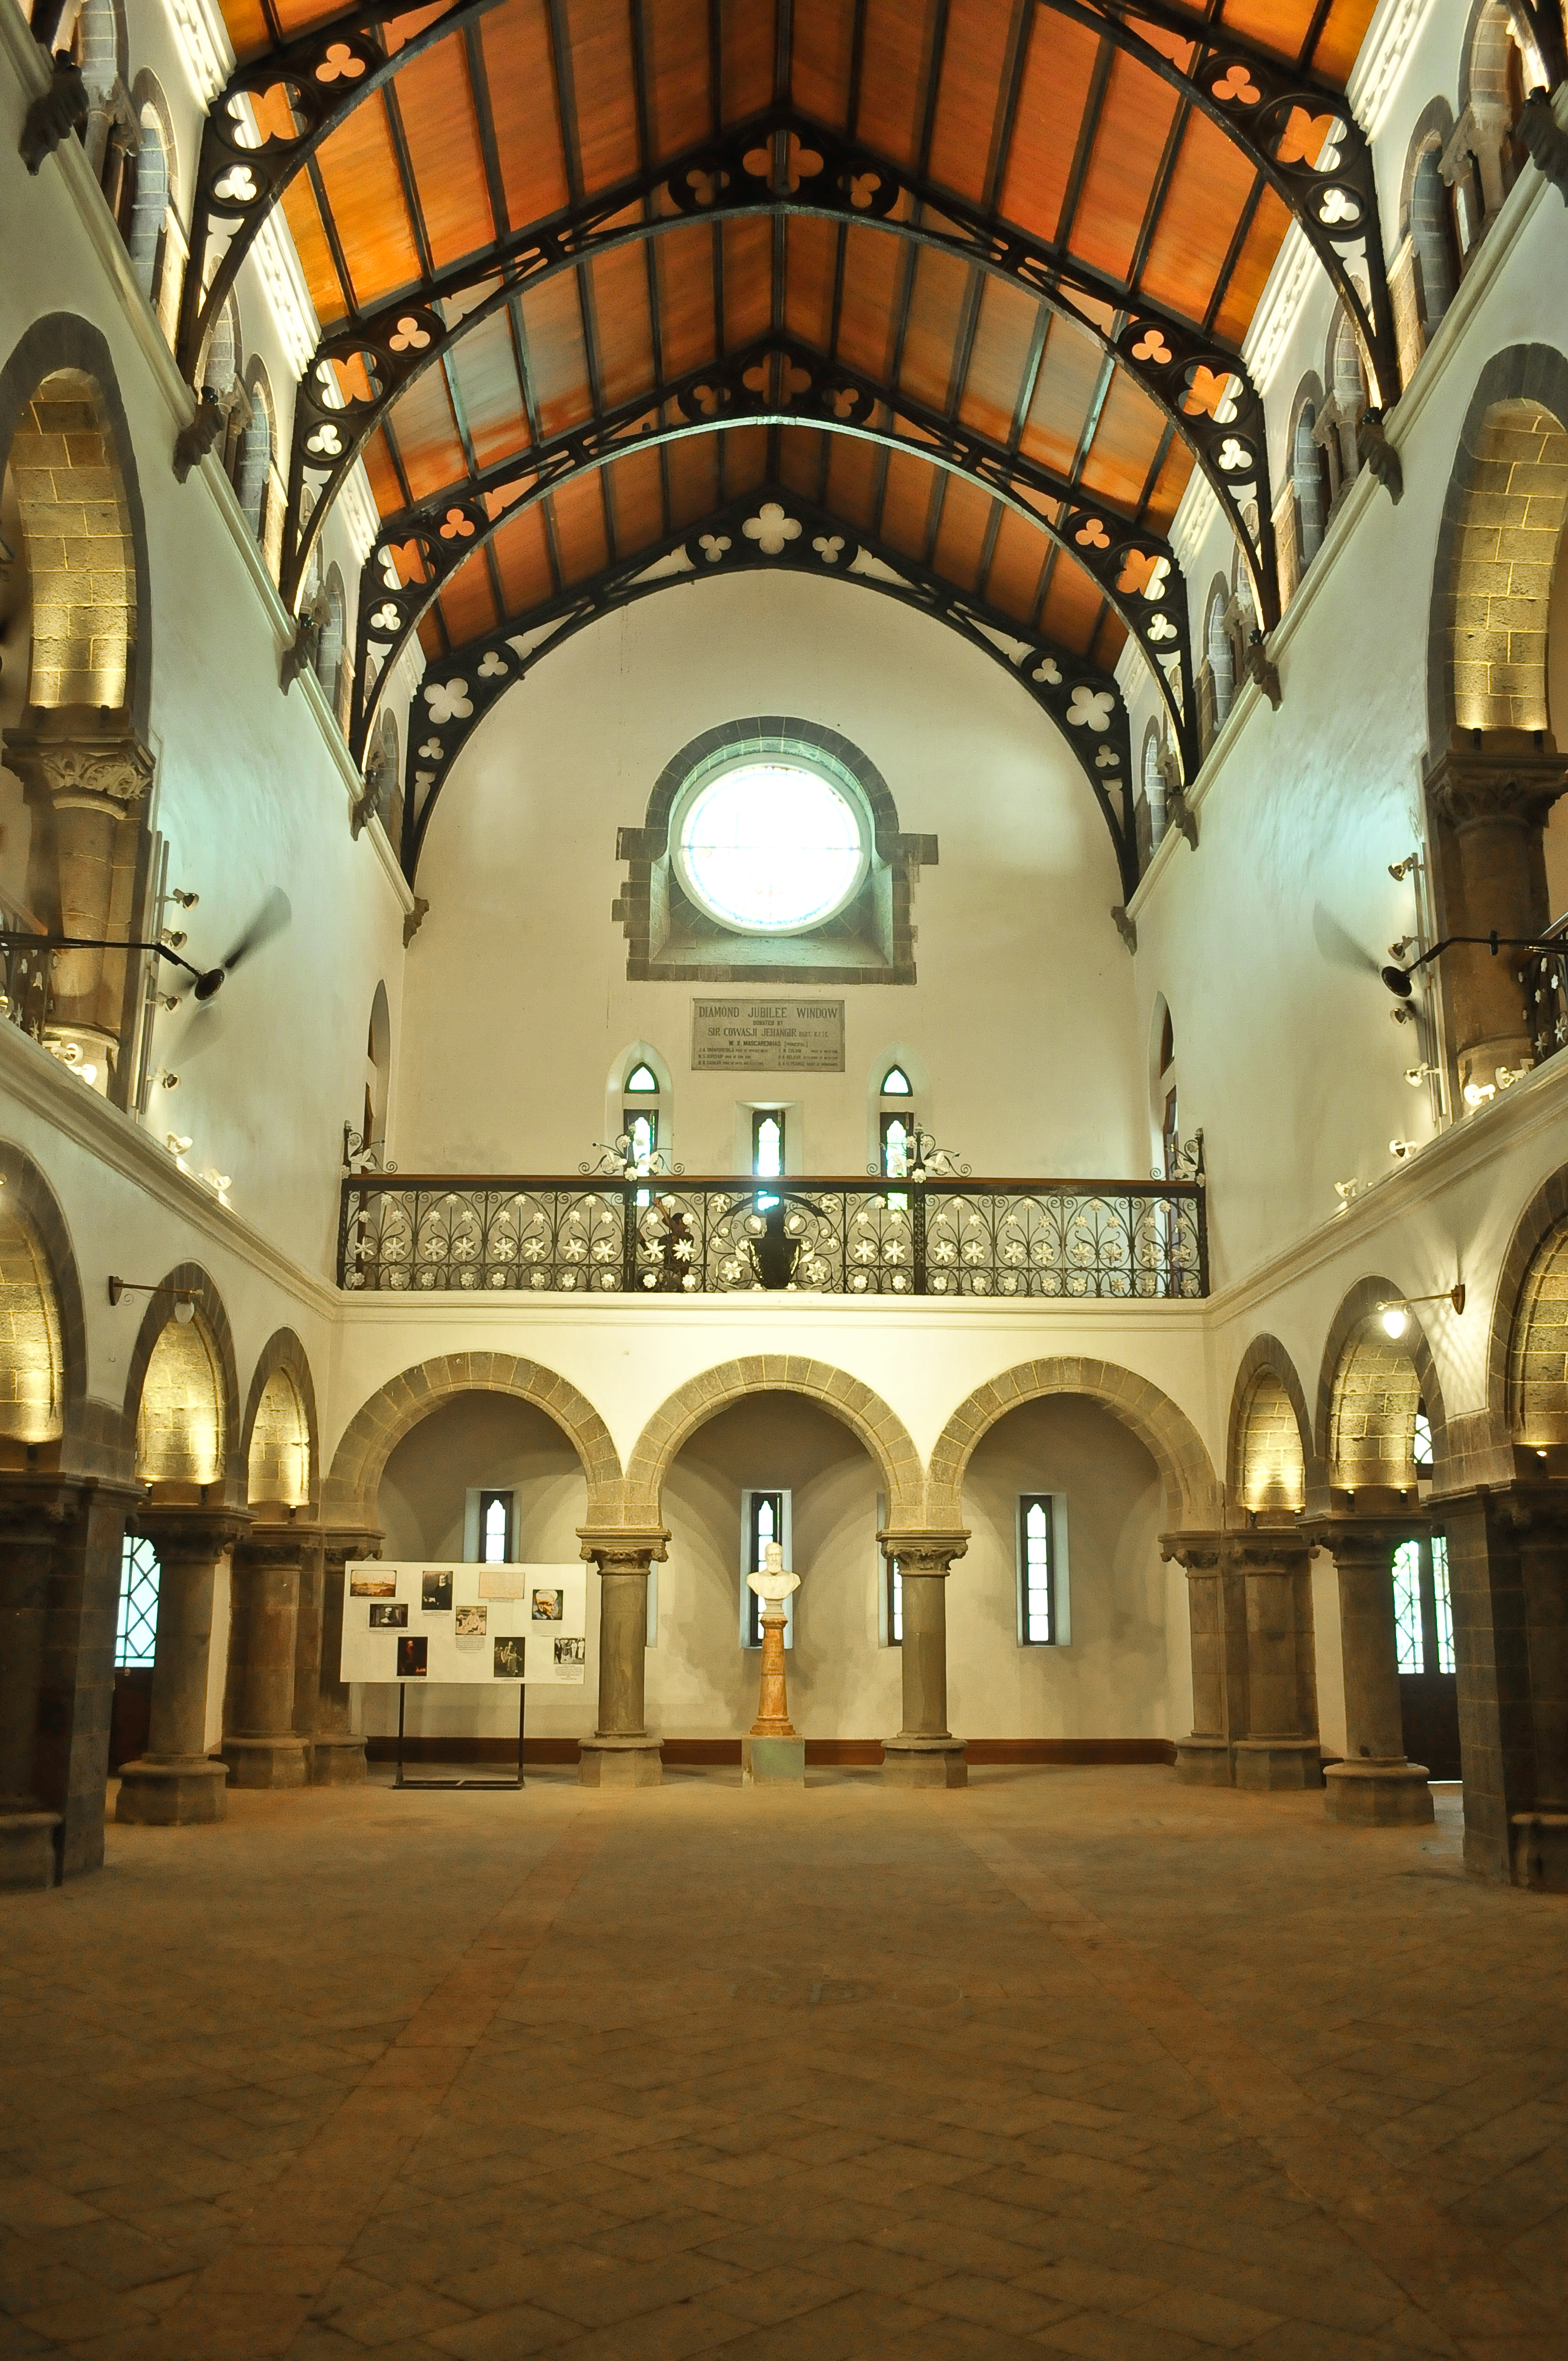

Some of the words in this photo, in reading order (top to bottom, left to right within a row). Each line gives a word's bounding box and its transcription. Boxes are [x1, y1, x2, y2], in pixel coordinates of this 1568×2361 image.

[699, 1007, 739, 1018] DIAMOND
[748, 1007, 787, 1018] JUBILEE
[797, 1008, 837, 1019] WINDOW
[707, 1027, 721, 1036] SIR
[723, 1027, 757, 1037] COWASJI
[761, 1028, 797, 1037] JEHANGIR
